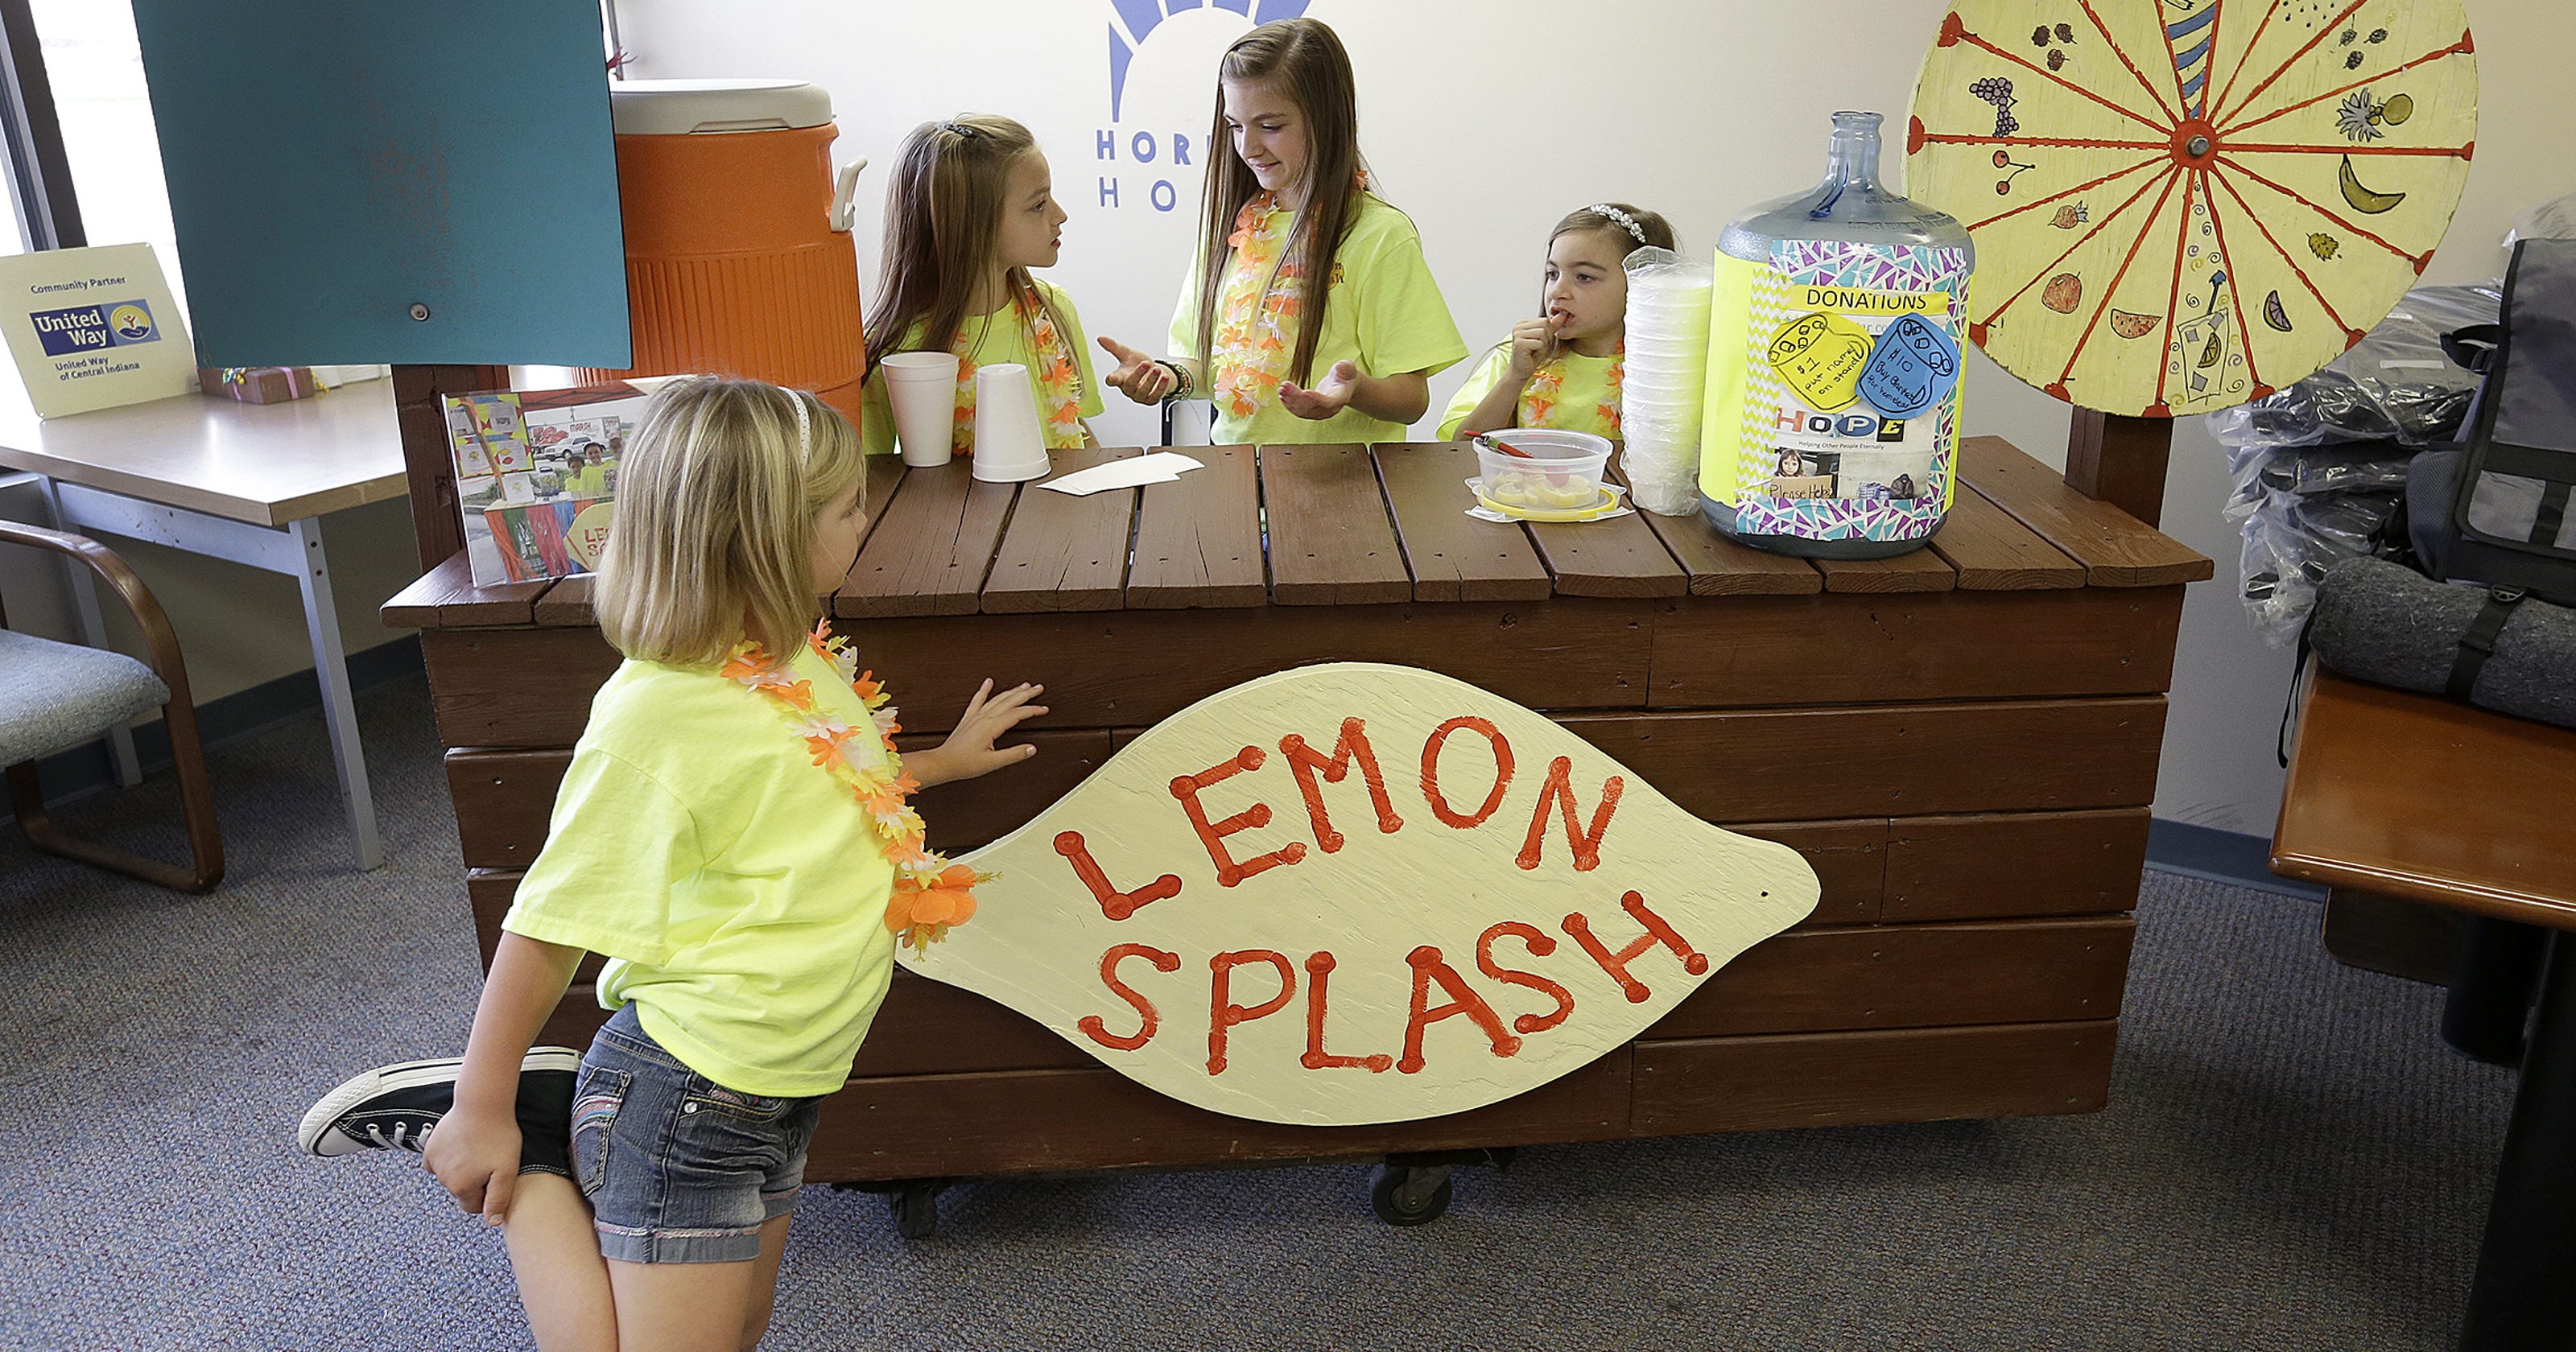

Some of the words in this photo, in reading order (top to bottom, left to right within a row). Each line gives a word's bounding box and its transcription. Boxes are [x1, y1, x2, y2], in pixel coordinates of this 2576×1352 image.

[1096, 130, 1210, 166] HOR
[30, 279, 89, 295] Community
[89, 276, 126, 289] Partner
[1806, 289, 1927, 310] DONATIONS
[35, 309, 104, 333] United
[67, 328, 109, 347] Way
[56, 358, 87, 371] United
[89, 357, 109, 367] Way
[1797, 357, 1821, 375] $1
[1805, 373, 1823, 392] put
[1827, 348, 1855, 371] name
[1888, 348, 1913, 372] $10
[60, 373, 70, 381] of
[71, 369, 105, 380] Central
[106, 362, 140, 374] Indiana
[1818, 385, 1833, 394] on
[1833, 357, 1860, 382] stand
[1875, 361, 1891, 382] Buy
[569, 422, 592, 433] MARSH
[1777, 407, 1904, 434] HOPE
[1798, 440, 1820, 448] Helping
[1053, 715, 1626, 920] LEMON
[1076, 889, 1709, 1075] SPLASH
